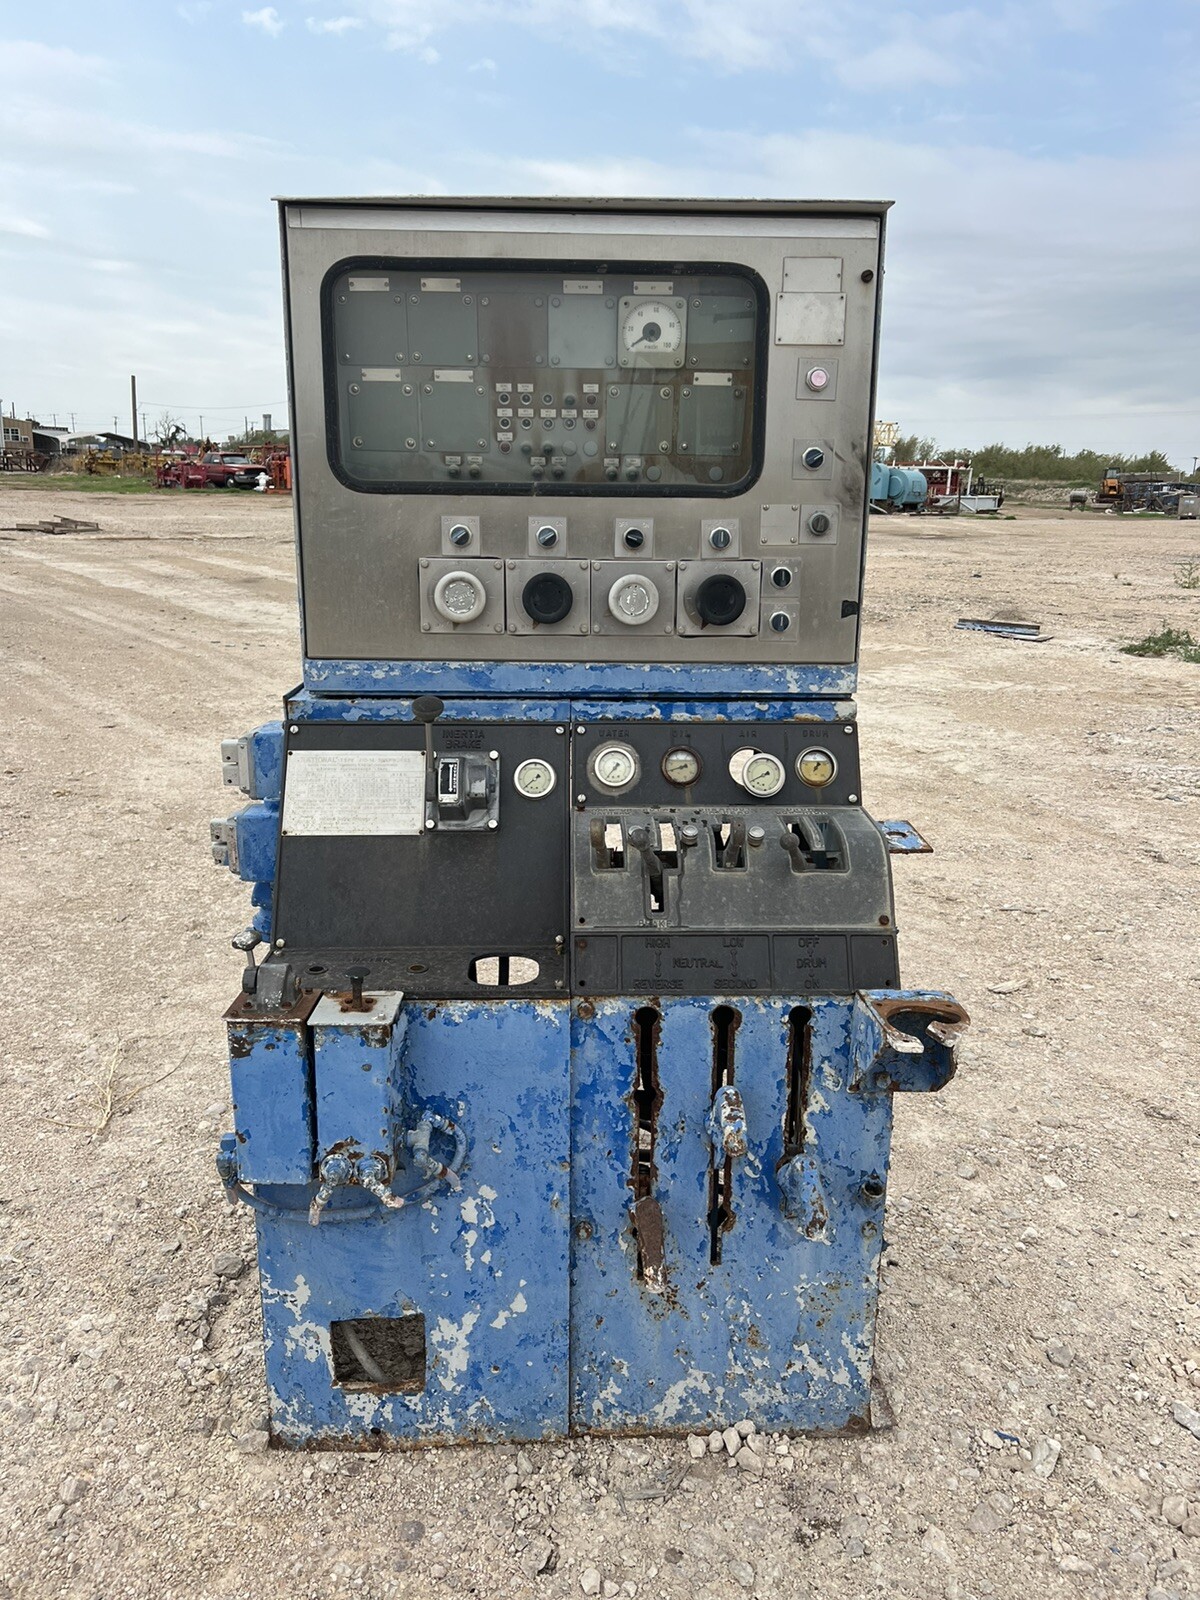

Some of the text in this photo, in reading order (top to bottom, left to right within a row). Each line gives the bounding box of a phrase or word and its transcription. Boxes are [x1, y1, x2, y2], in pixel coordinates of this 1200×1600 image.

[442, 729, 485, 739] INERTIA
[598, 729, 631, 739] WATER
[738, 729, 758, 739] AIR
[802, 729, 830, 739] DRUM
[446, 739, 482, 749] BRAKE
[645, 937, 671, 948] HIGH
[723, 937, 746, 948] LOW
[798, 937, 820, 948] OFF
[672, 957, 724, 969] NEUTRAL
[796, 957, 828, 969] DRUM
[633, 979, 684, 990] REVERSE
[713, 978, 758, 990] SECOND
[803, 978, 821, 990] ON
